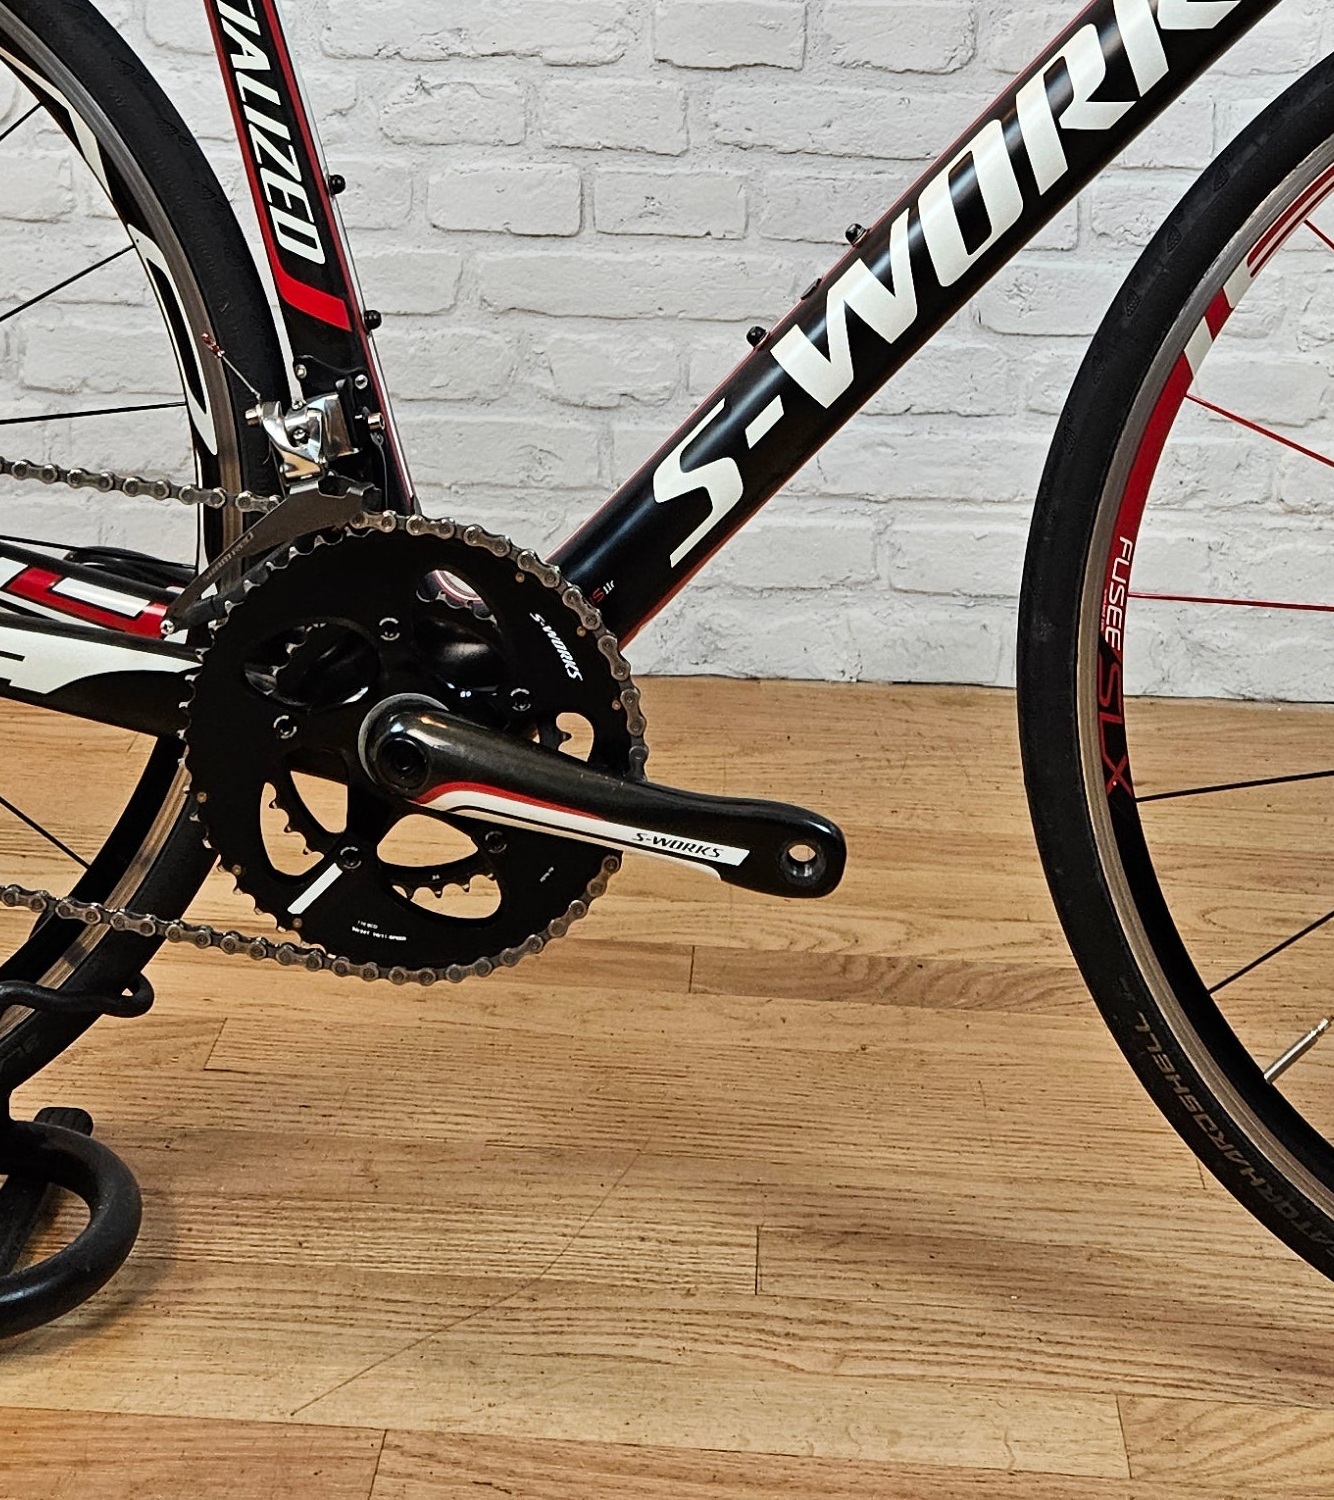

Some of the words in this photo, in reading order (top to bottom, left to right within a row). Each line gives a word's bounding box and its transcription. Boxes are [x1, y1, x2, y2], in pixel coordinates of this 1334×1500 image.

[1104, 535, 1134, 651] FUSEE
[529, 612, 584, 682] S-WORKS
[1097, 650, 1136, 798] SLX
[631, 832, 724, 859] S-WORKS
